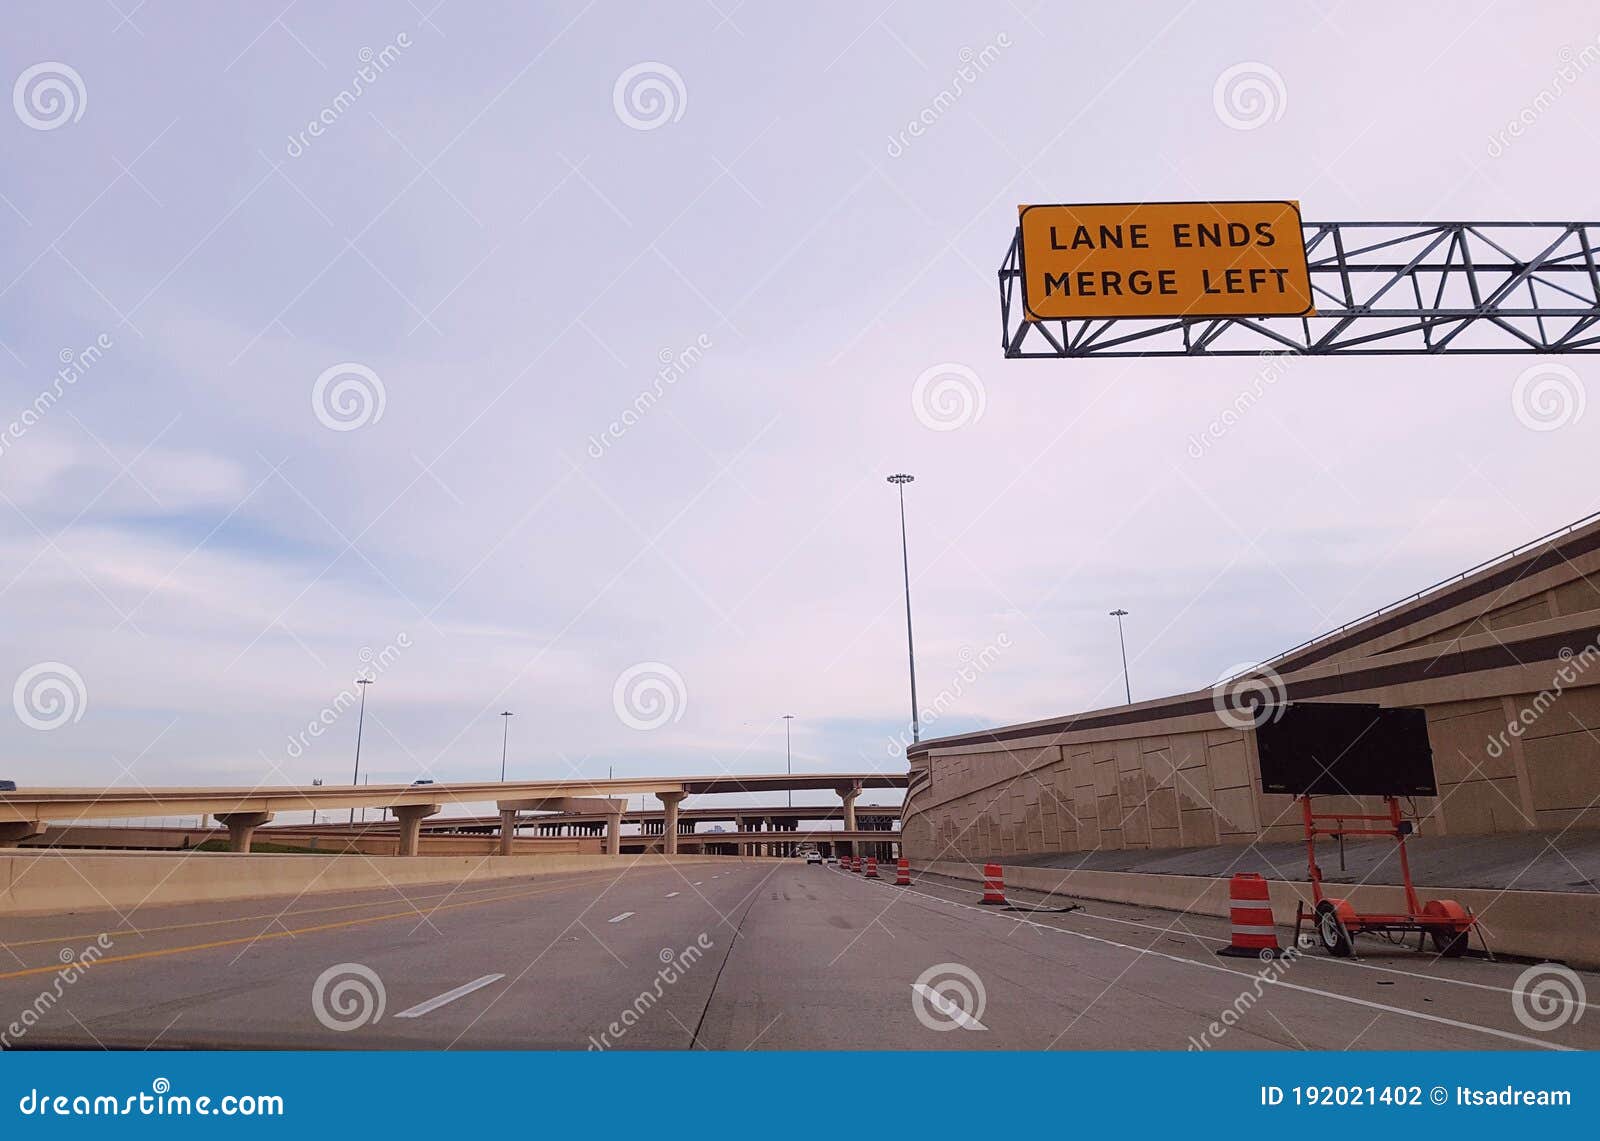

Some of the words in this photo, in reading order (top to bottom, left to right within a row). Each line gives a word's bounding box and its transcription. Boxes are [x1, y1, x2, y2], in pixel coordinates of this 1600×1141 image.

[1050, 224, 1149, 250] LANE
[1173, 222, 1275, 248] ENDS
[1044, 270, 1178, 296] MERGE
[1202, 268, 1288, 294] LEFT
